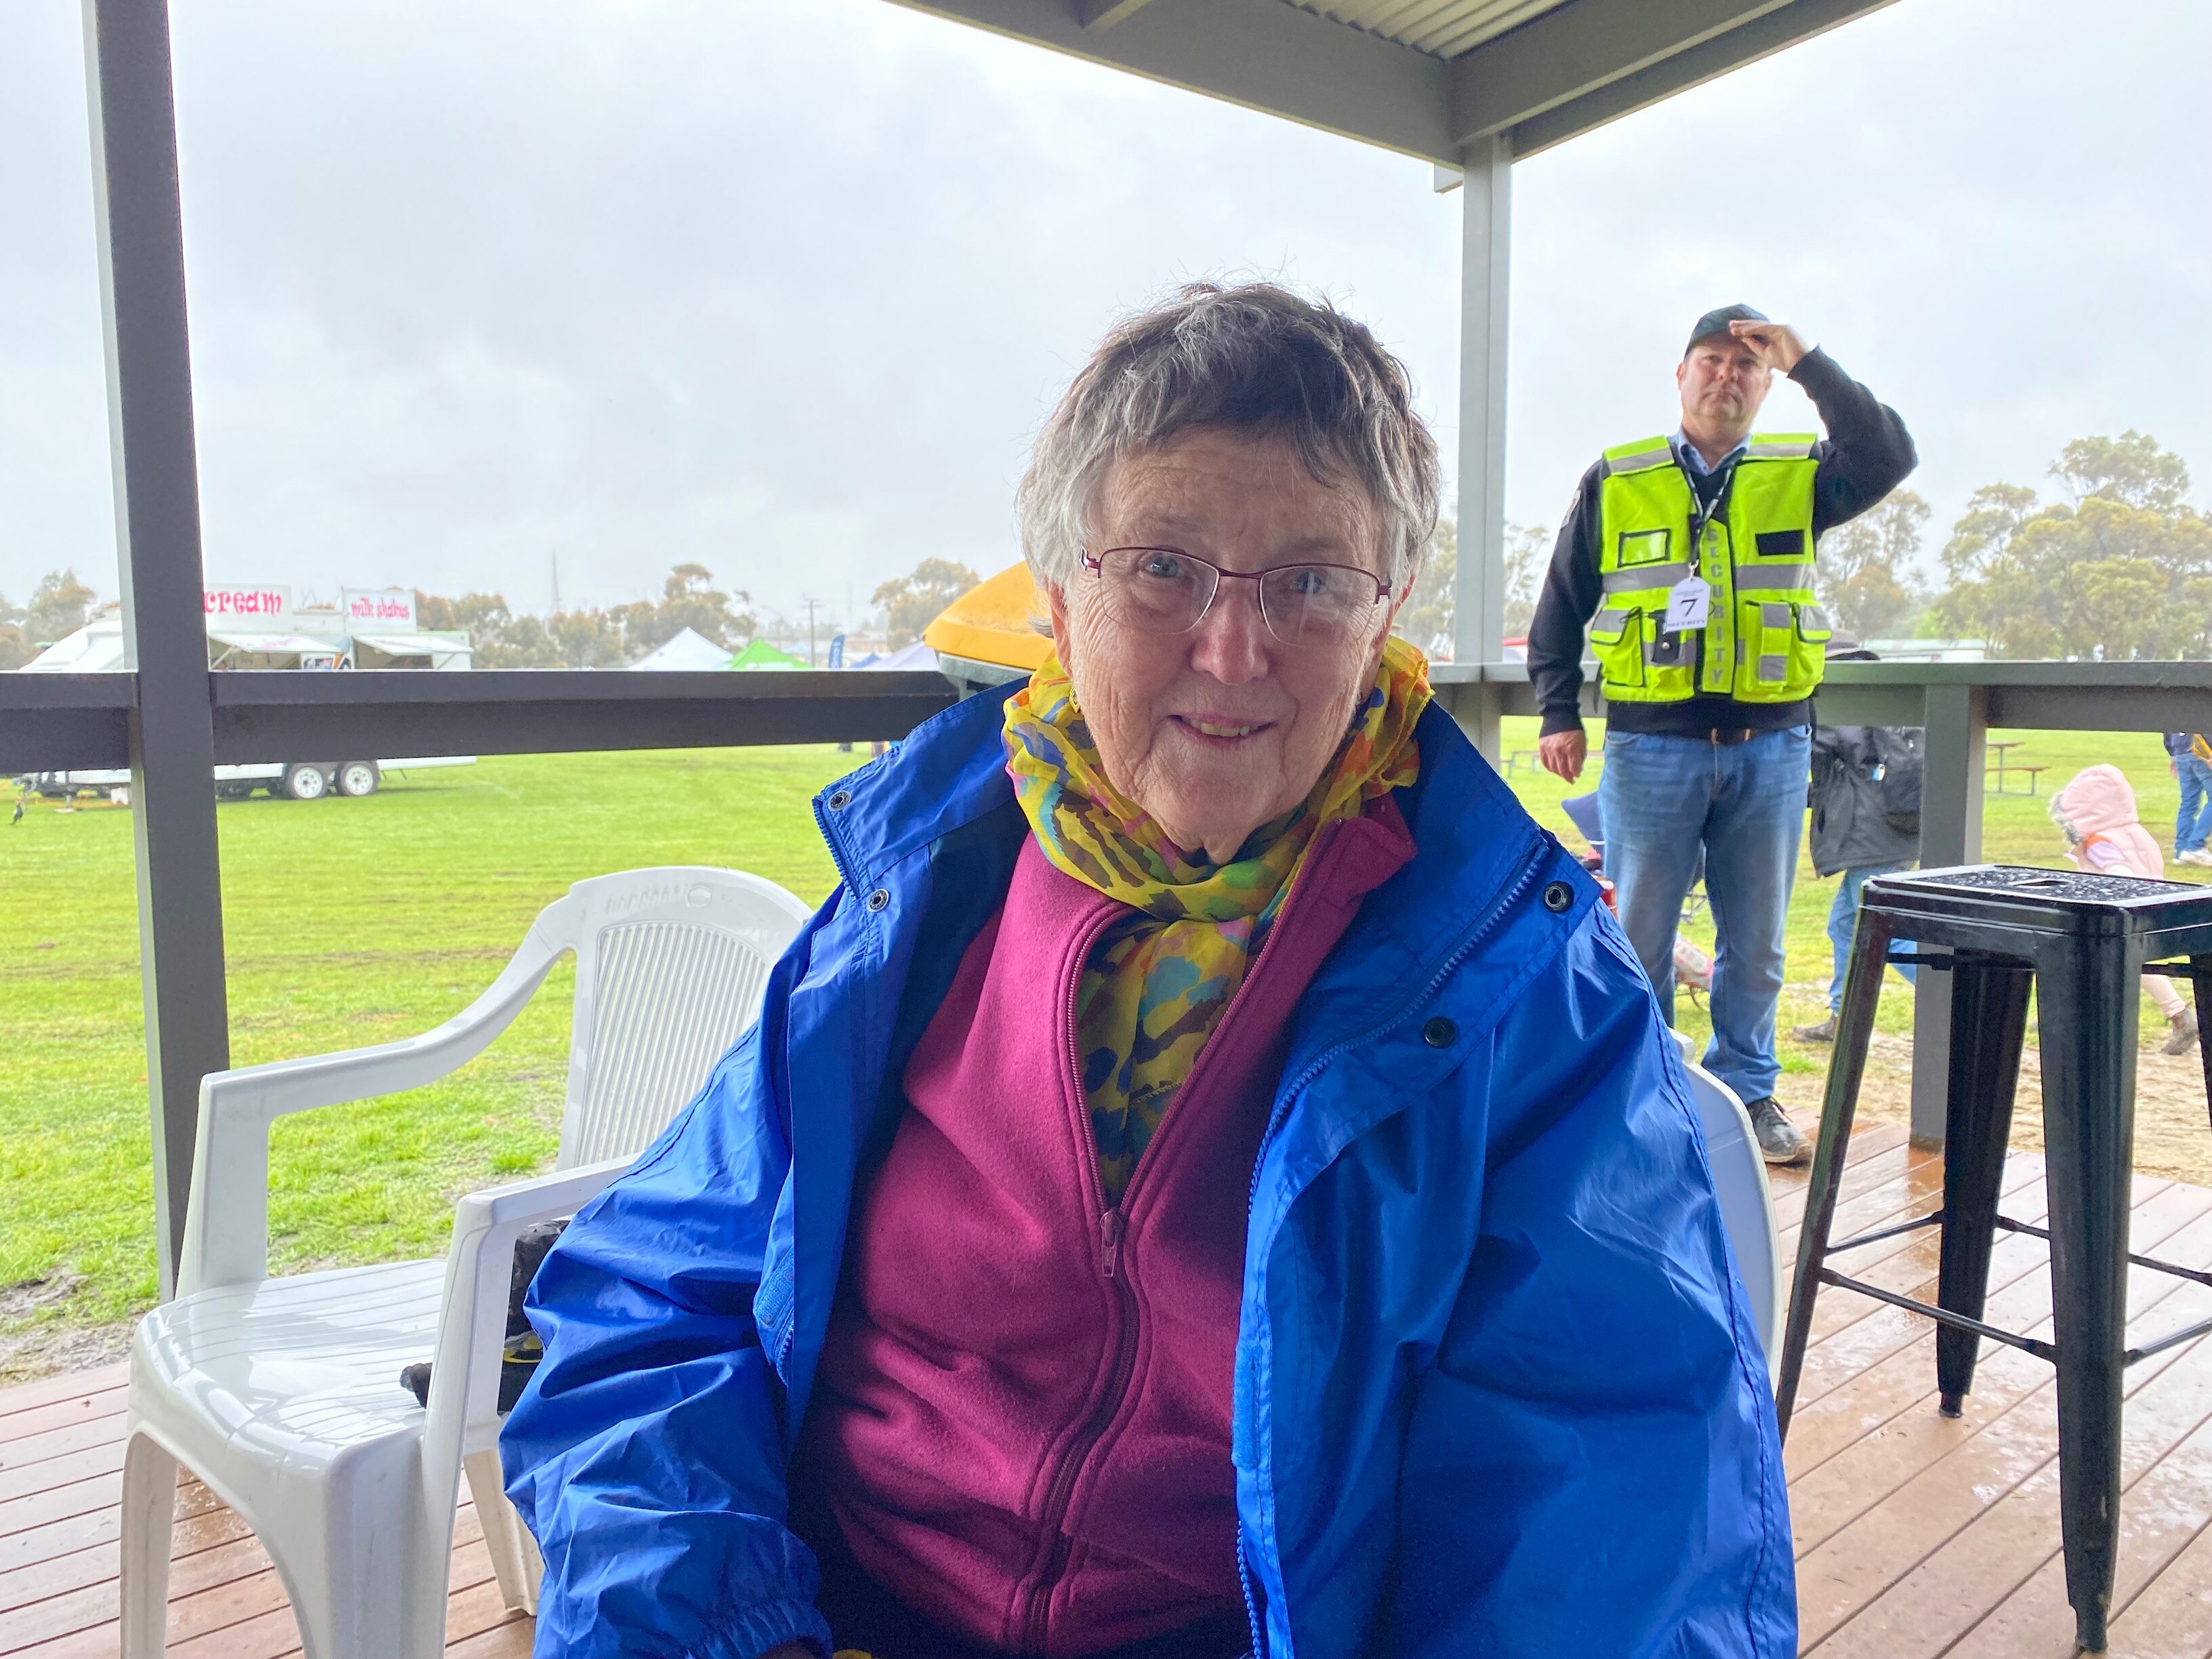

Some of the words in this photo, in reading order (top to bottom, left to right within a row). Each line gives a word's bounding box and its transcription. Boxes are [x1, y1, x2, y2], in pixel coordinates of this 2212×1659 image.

[203, 589, 282, 616] cream
[351, 596, 374, 618] milk
[1680, 598, 1698, 617] 7
[1707, 529, 1725, 685] SECURITY
